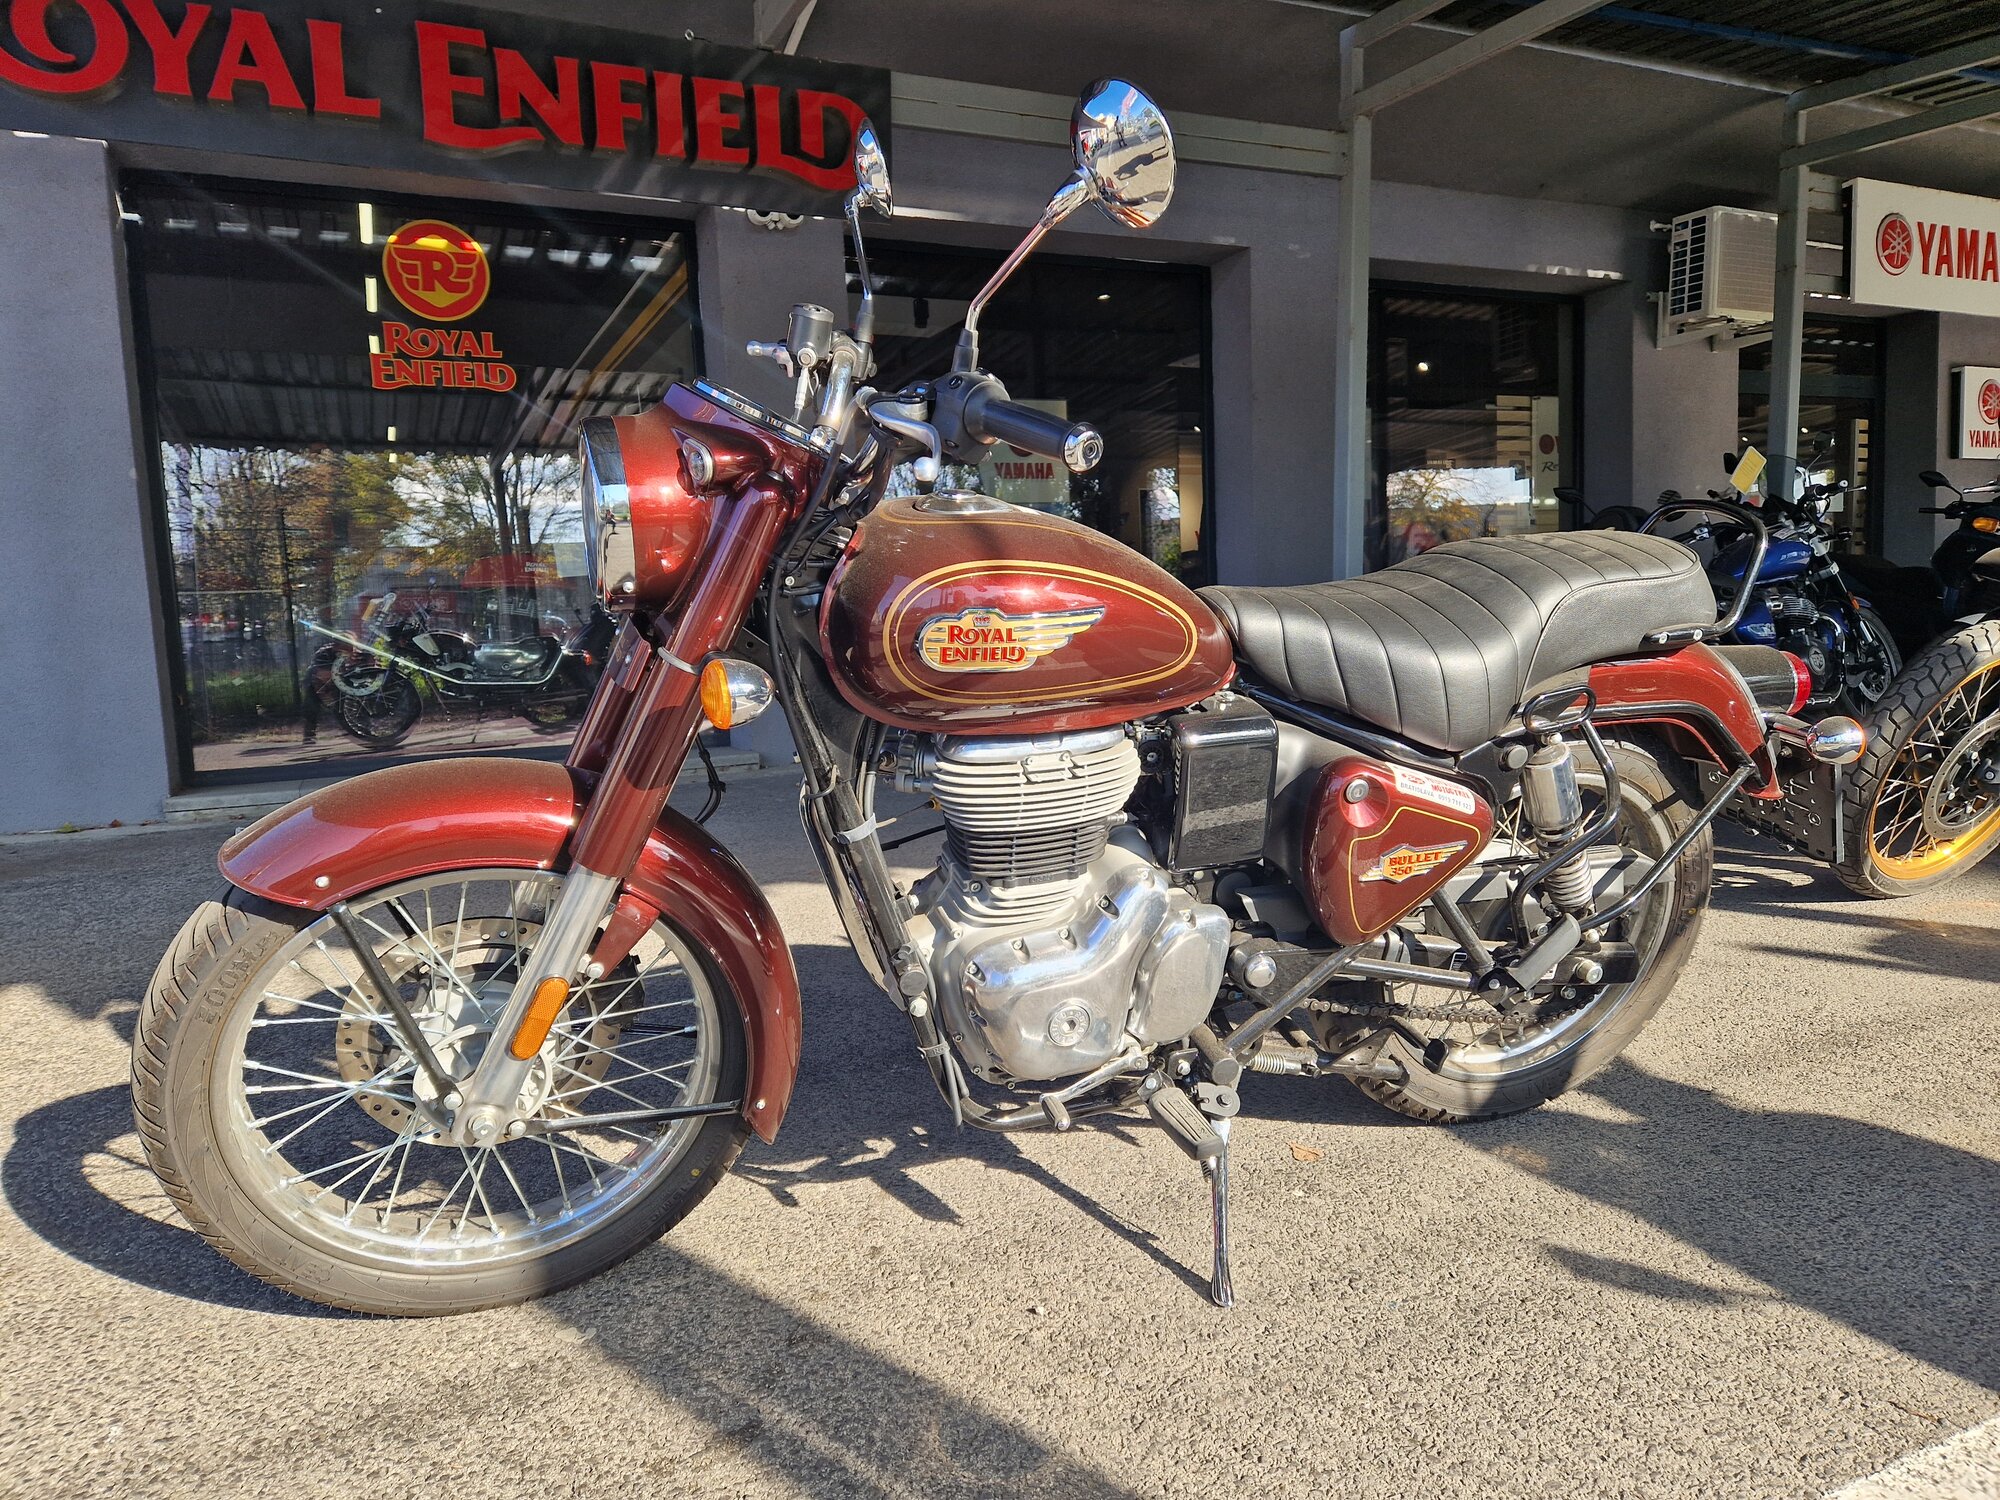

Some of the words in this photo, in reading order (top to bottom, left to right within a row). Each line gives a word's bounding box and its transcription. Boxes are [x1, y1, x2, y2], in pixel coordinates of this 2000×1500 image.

[0, 0, 381, 118] OYAL
[415, 20, 870, 192] ENFIELD
[382, 321, 503, 358] ROYAL
[369, 353, 517, 392] ENFIELD
[1969, 430, 2000, 448] YAMA
[994, 462, 1055, 479] YAMAHA
[947, 625, 1019, 646] ROYAL
[939, 646, 1026, 664] ENFIELD
[1388, 851, 1442, 866] BULLET
[1390, 866, 1412, 877] 350
